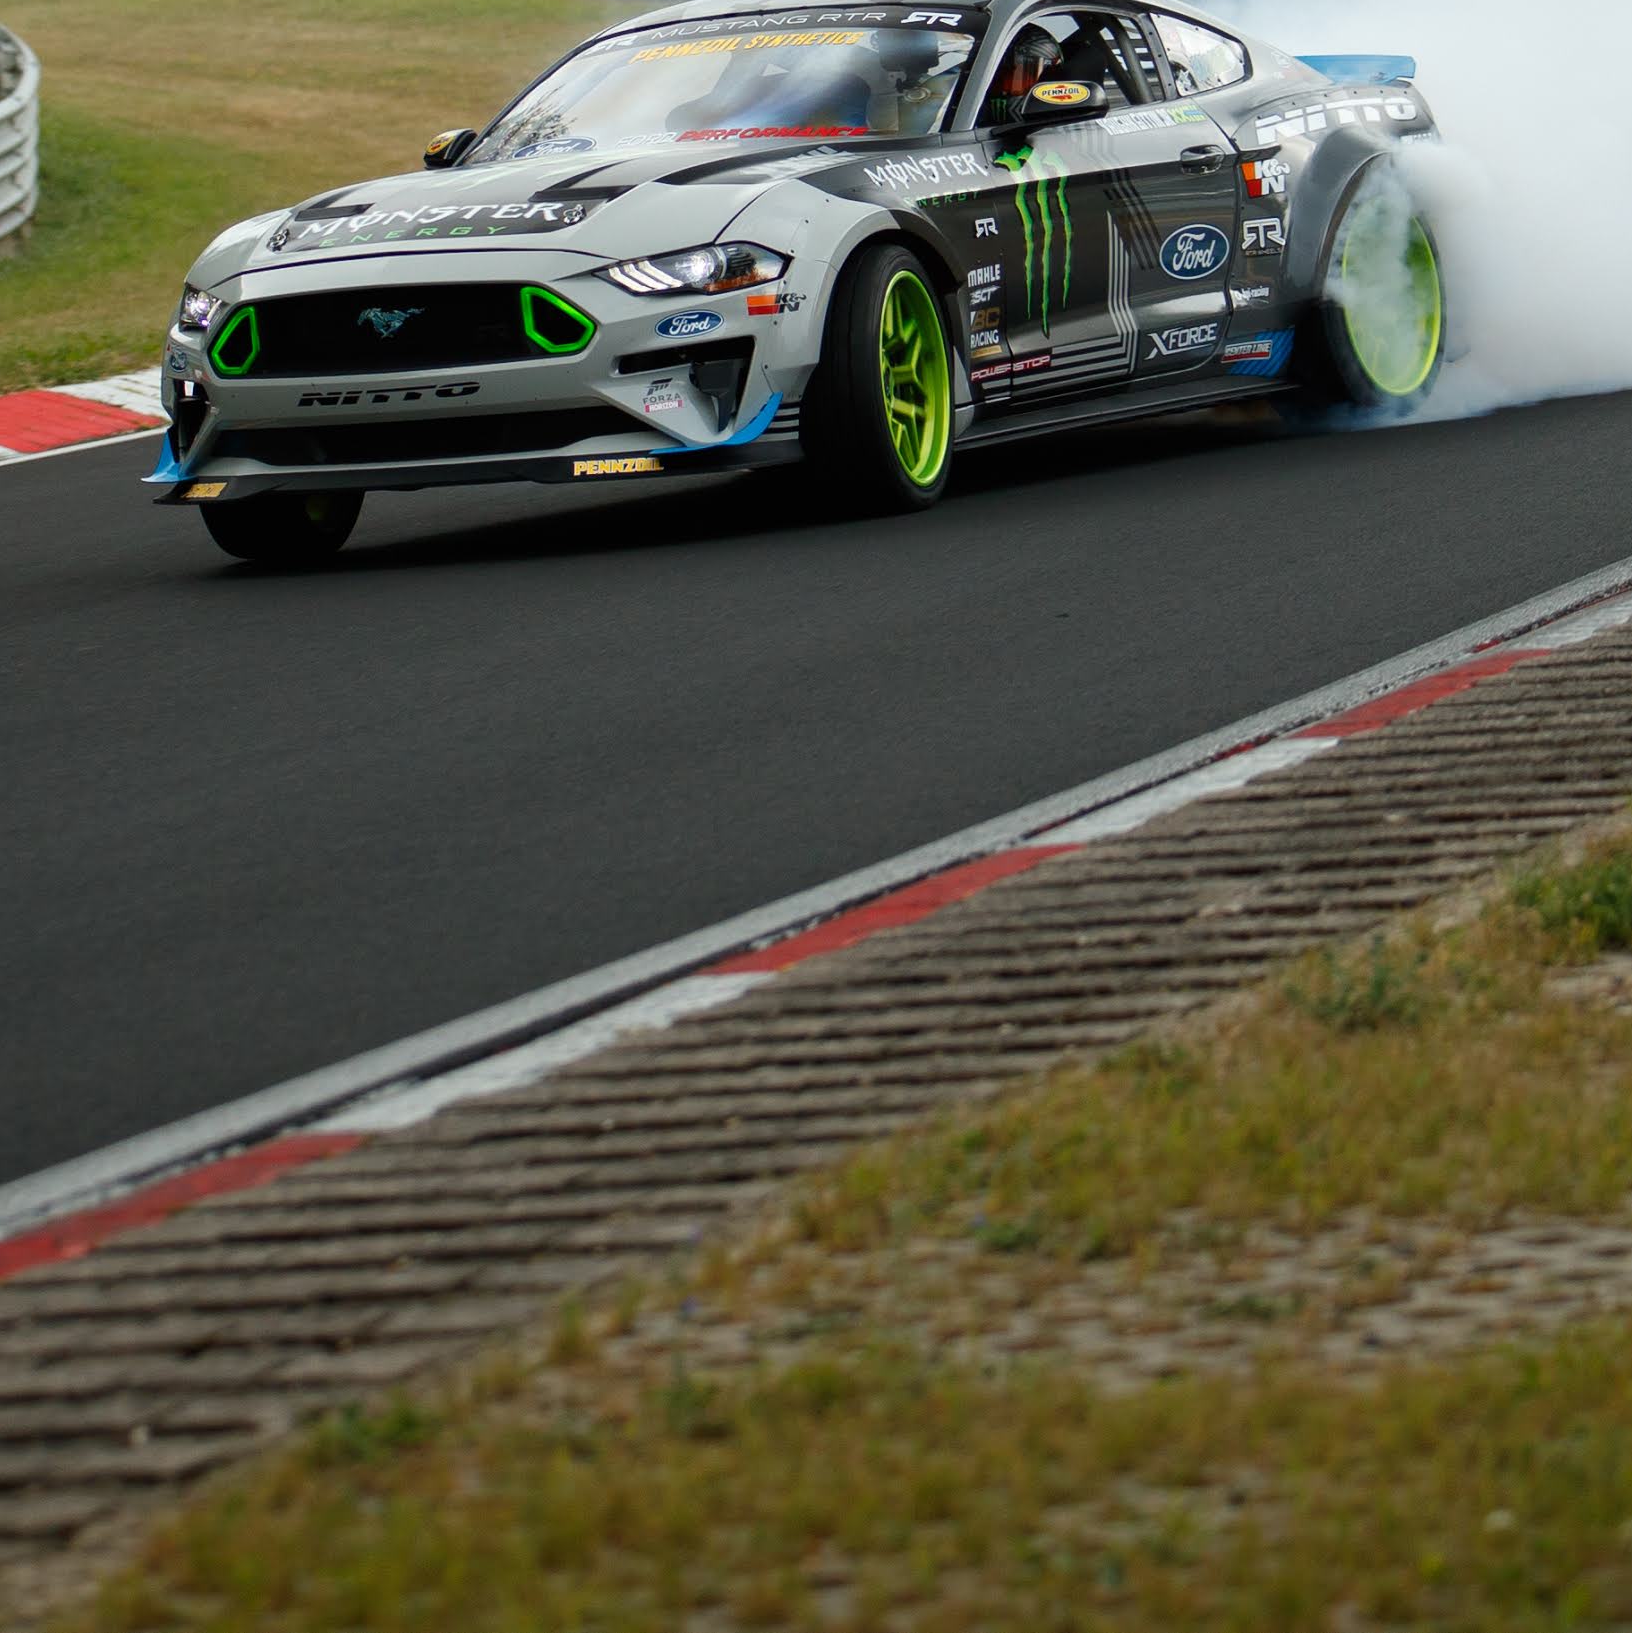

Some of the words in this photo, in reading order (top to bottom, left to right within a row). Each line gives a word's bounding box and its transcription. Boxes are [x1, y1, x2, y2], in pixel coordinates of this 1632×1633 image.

[651, 14, 811, 40] MUSTANG
[816, 12, 887, 23] RTR
[628, 37, 743, 64] PENNZOIL
[745, 31, 865, 50] SYNTHETICS
[1041, 87, 1080, 97] PENNZOIL
[1255, 97, 1417, 146] NITTO
[676, 125, 870, 143] PERFORMANCE
[864, 151, 989, 190] MONSTER
[297, 201, 565, 240] MONSTER
[318, 226, 509, 248] ENERGY
[968, 264, 1001, 287] MAHLE
[971, 307, 1001, 330] BC
[970, 330, 999, 349] RACING
[298, 381, 481, 407] NITTO
[643, 392, 682, 404] FORZA
[573, 457, 665, 477] PENNZOIL
